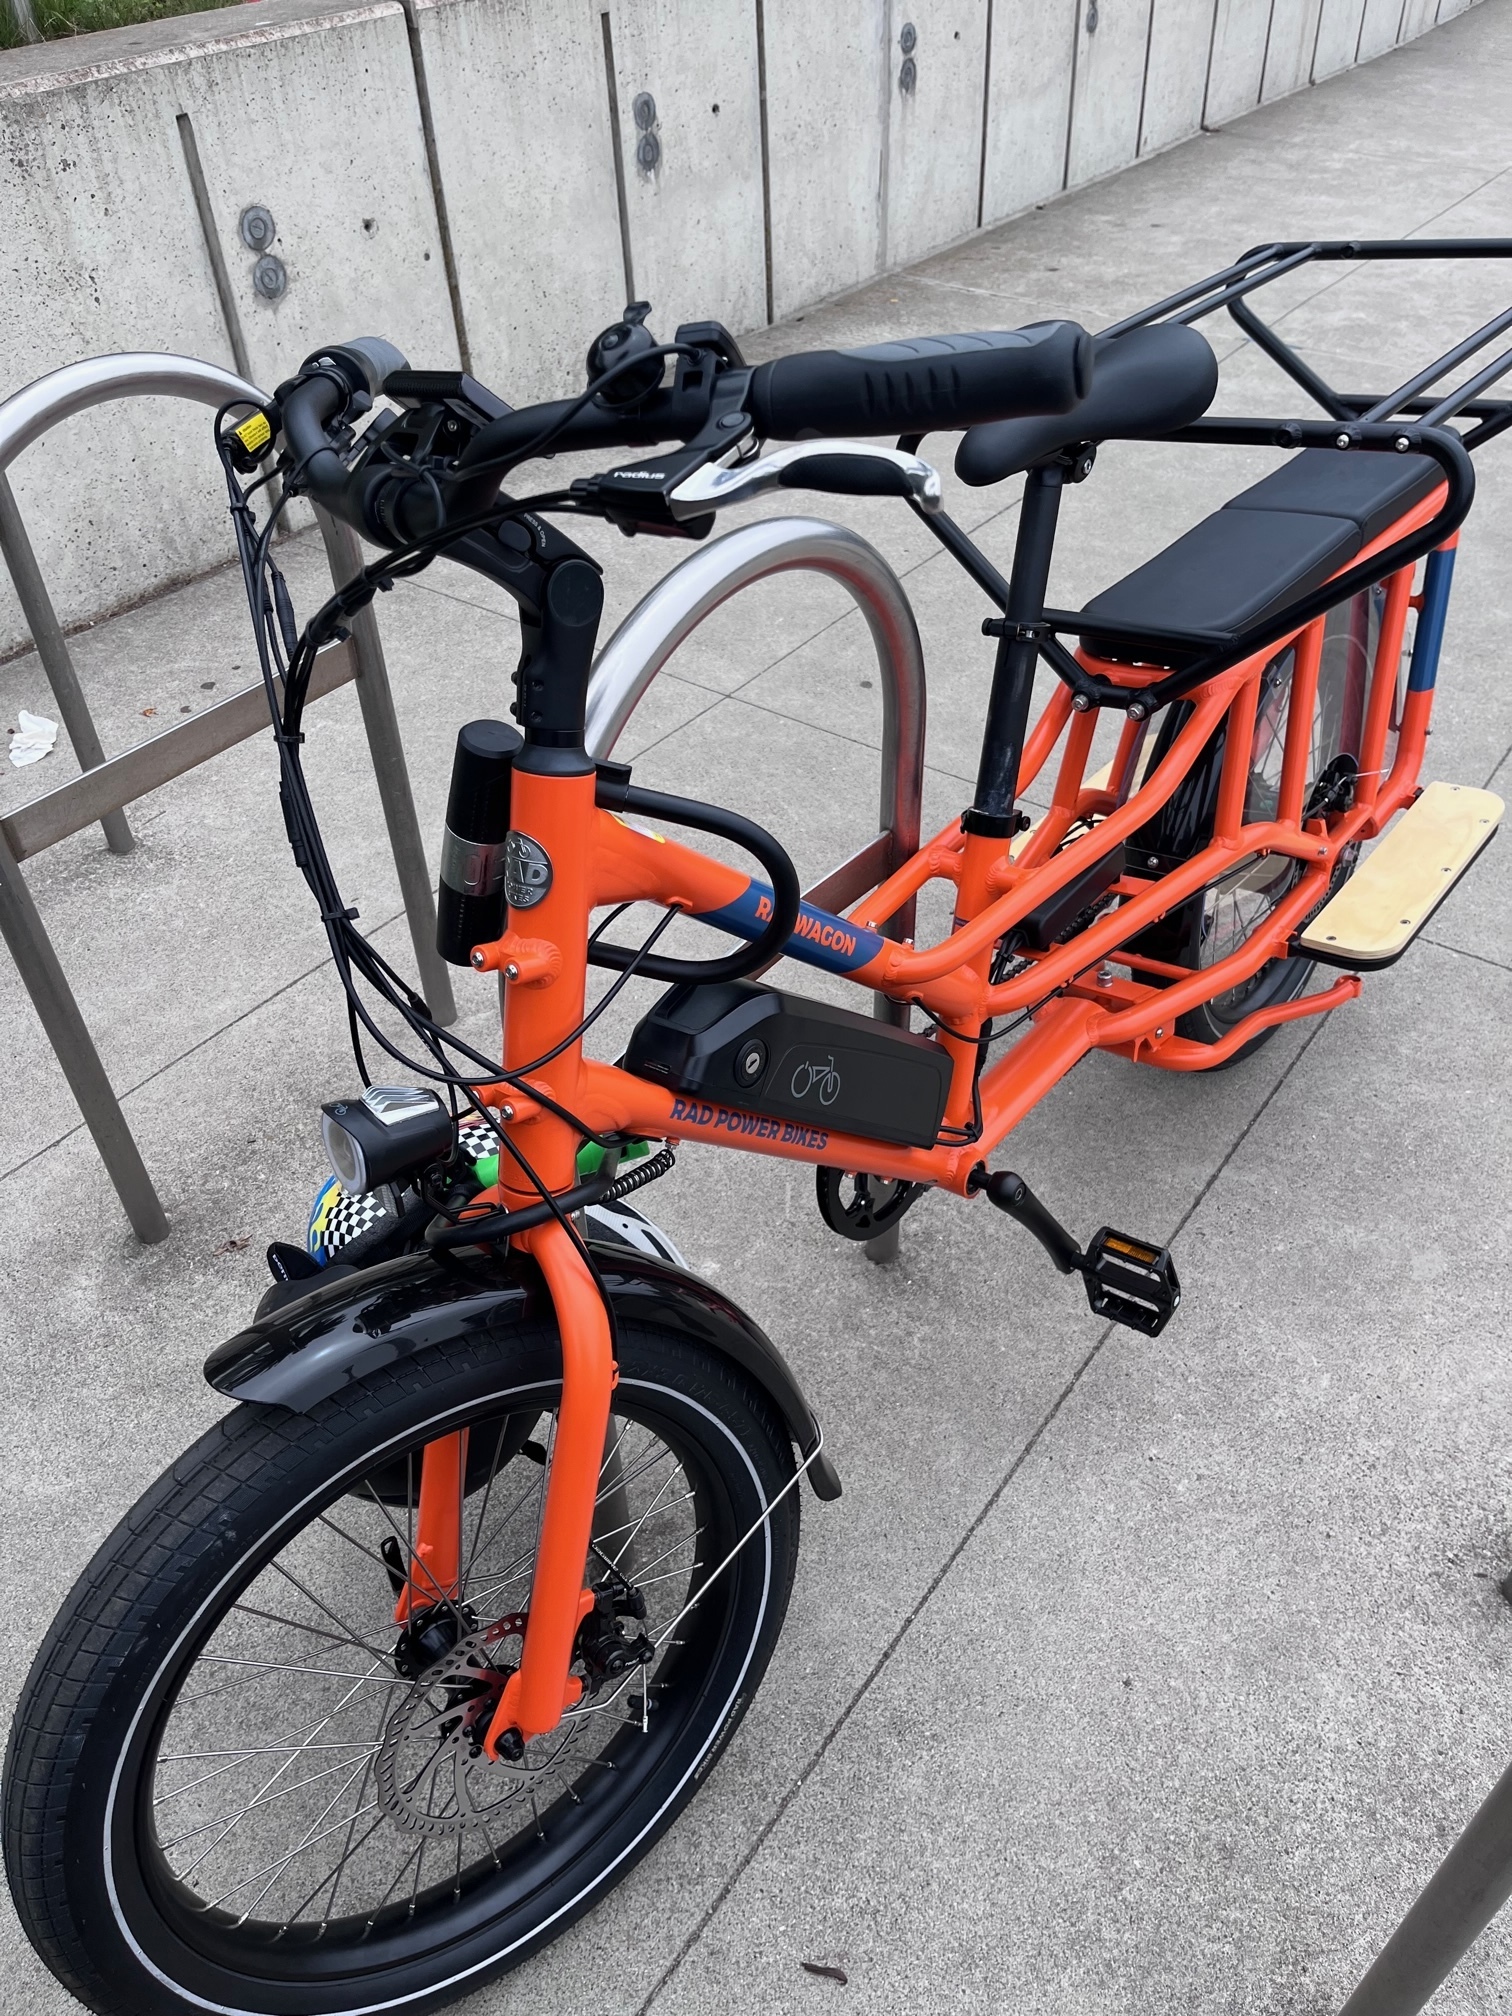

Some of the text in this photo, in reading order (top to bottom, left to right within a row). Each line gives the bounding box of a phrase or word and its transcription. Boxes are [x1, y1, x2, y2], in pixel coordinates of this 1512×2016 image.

[613, 470, 666, 480] radius
[539, 530, 547, 548] OPEN
[755, 896, 857, 956] RWAGON
[670, 1098, 829, 1150] RAD POWER BIKES
[694, 1698, 742, 1780] RAD POWER BIKES
